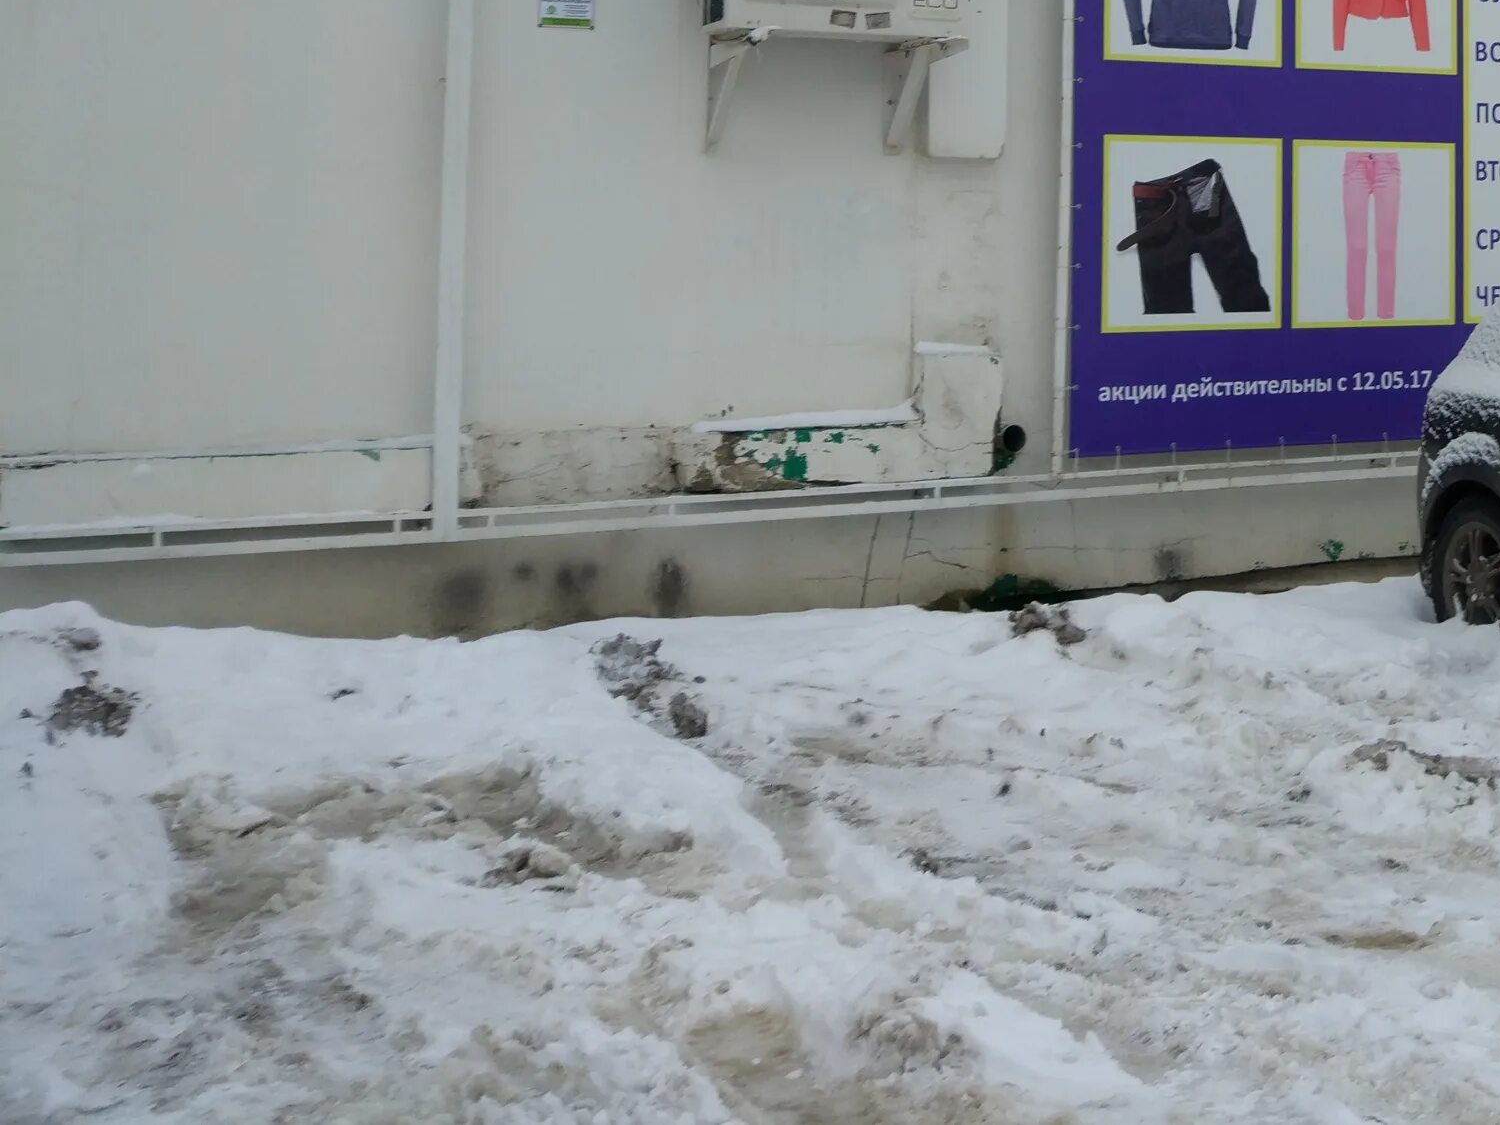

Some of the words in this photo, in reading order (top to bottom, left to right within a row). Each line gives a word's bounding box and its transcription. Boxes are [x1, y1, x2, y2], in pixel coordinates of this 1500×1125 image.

[1099, 385, 1166, 404] акции
[1172, 377, 1331, 402] действительны
[1337, 378, 1347, 391] с
[1352, 370, 1432, 391] 12.05.17
